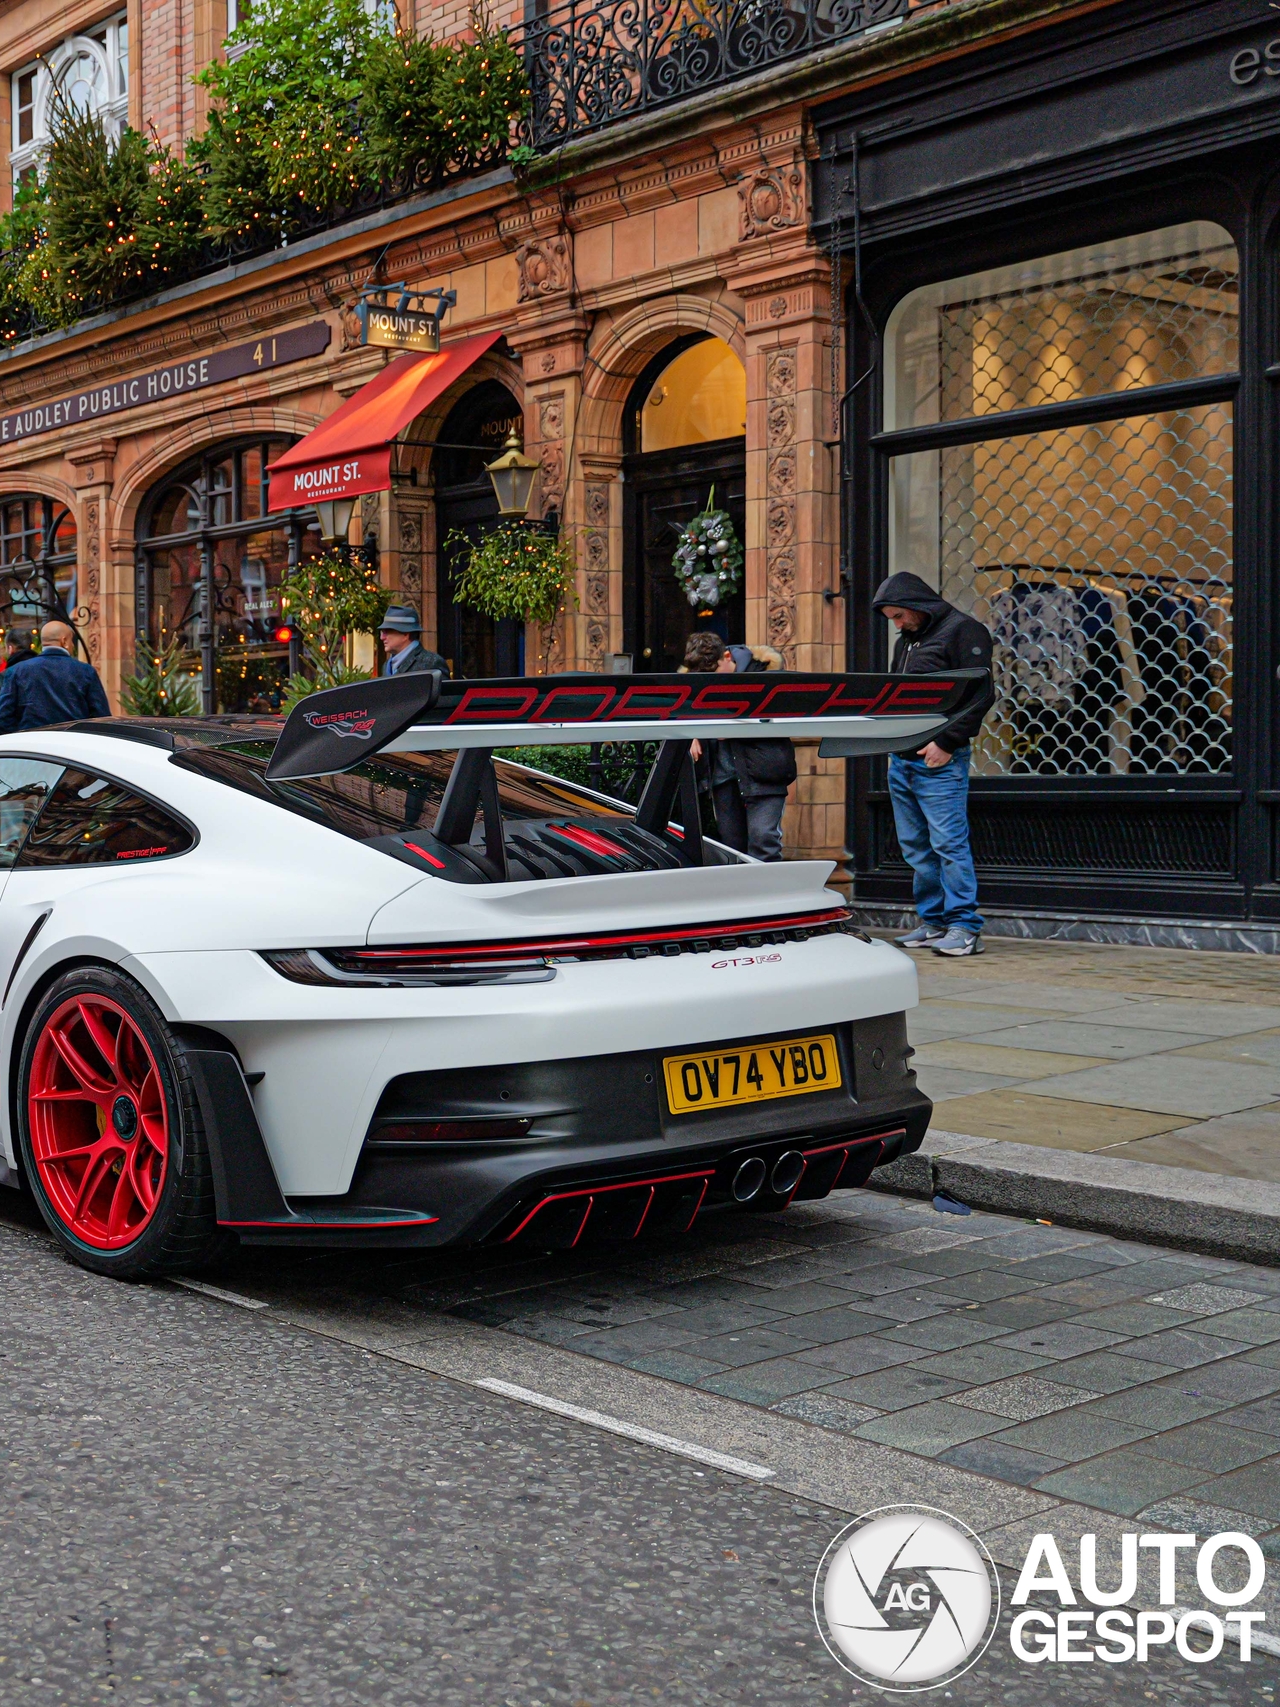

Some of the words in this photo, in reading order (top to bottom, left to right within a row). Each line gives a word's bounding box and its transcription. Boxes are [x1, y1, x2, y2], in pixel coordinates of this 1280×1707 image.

[369, 312, 416, 333] MOUNT
[418, 319, 436, 336] ST.
[383, 332, 421, 342] RESTAURANT
[14, 400, 72, 436] AUDLEY
[78, 380, 140, 417] PUBLIC
[147, 358, 209, 397] HOUSE
[252, 338, 277, 365] 41
[293, 465, 340, 491] MOUNT
[343, 462, 362, 481] ST.
[307, 485, 346, 498] RESTAURANT
[244, 602, 259, 611] REAL
[260, 600, 273, 609] ALES
[442, 681, 955, 725] PORSCHE
[312, 709, 368, 724] WEISSACH
[630, 929, 810, 960] PORSCHE
[681, 1053, 764, 1102] OV74
[770, 1043, 827, 1088] YBO
